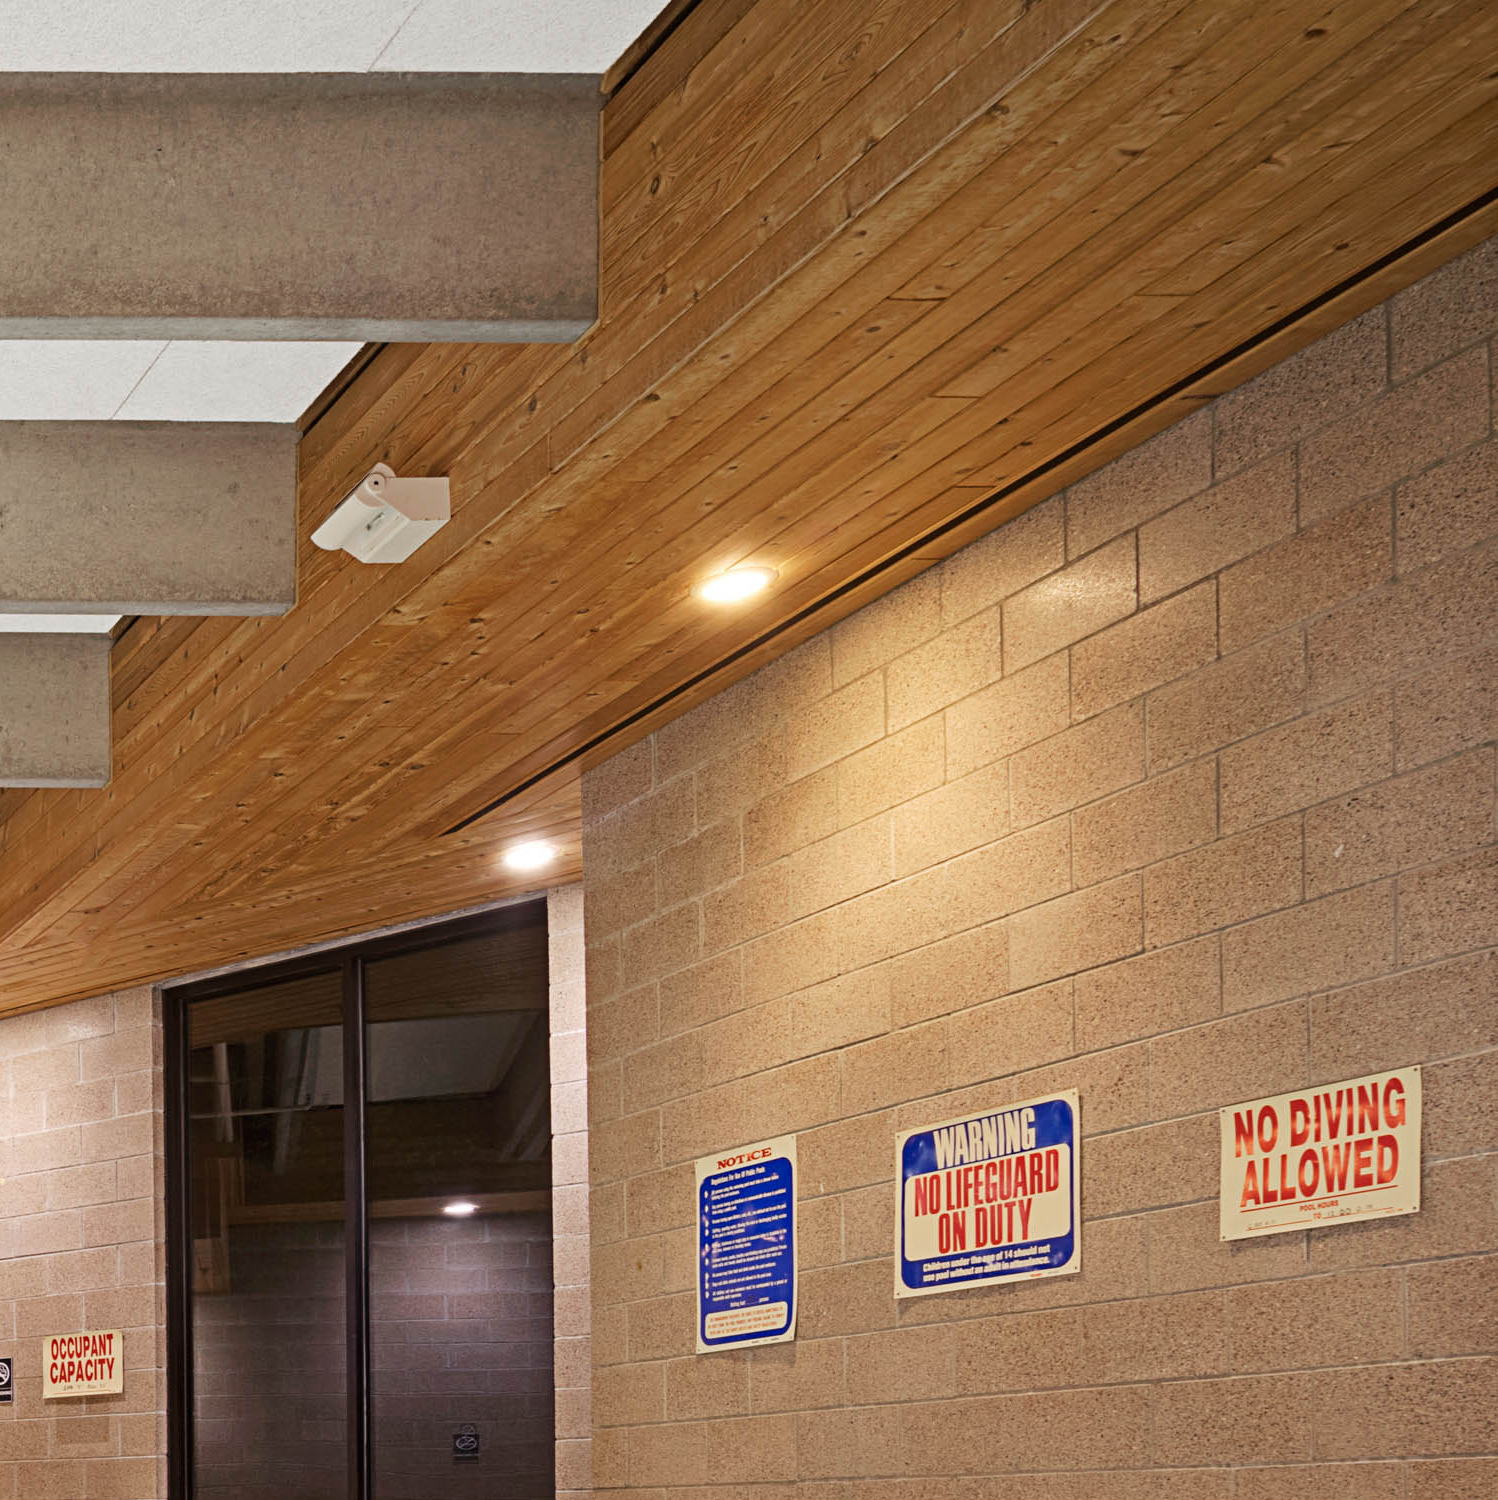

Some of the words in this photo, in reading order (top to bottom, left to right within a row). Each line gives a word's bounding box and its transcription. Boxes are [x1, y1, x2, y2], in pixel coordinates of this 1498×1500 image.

[1234, 1105, 1279, 1158] NO
[1289, 1077, 1406, 1147] DIVING
[717, 1147, 772, 1170] NOTICE
[933, 1108, 1036, 1170] WARNING
[914, 1174, 941, 1217] NO
[947, 1149, 1059, 1211] LIFEGUARD
[1239, 1134, 1399, 1208] ALLOWED
[938, 1211, 966, 1254] ON
[975, 1197, 1032, 1248] DUTY
[1299, 1204, 1316, 1212] POOL
[1005, 1249, 1013, 1259] 14
[51, 1333, 113, 1360] OCCUPANT
[50, 1357, 115, 1384] CAPACITY
